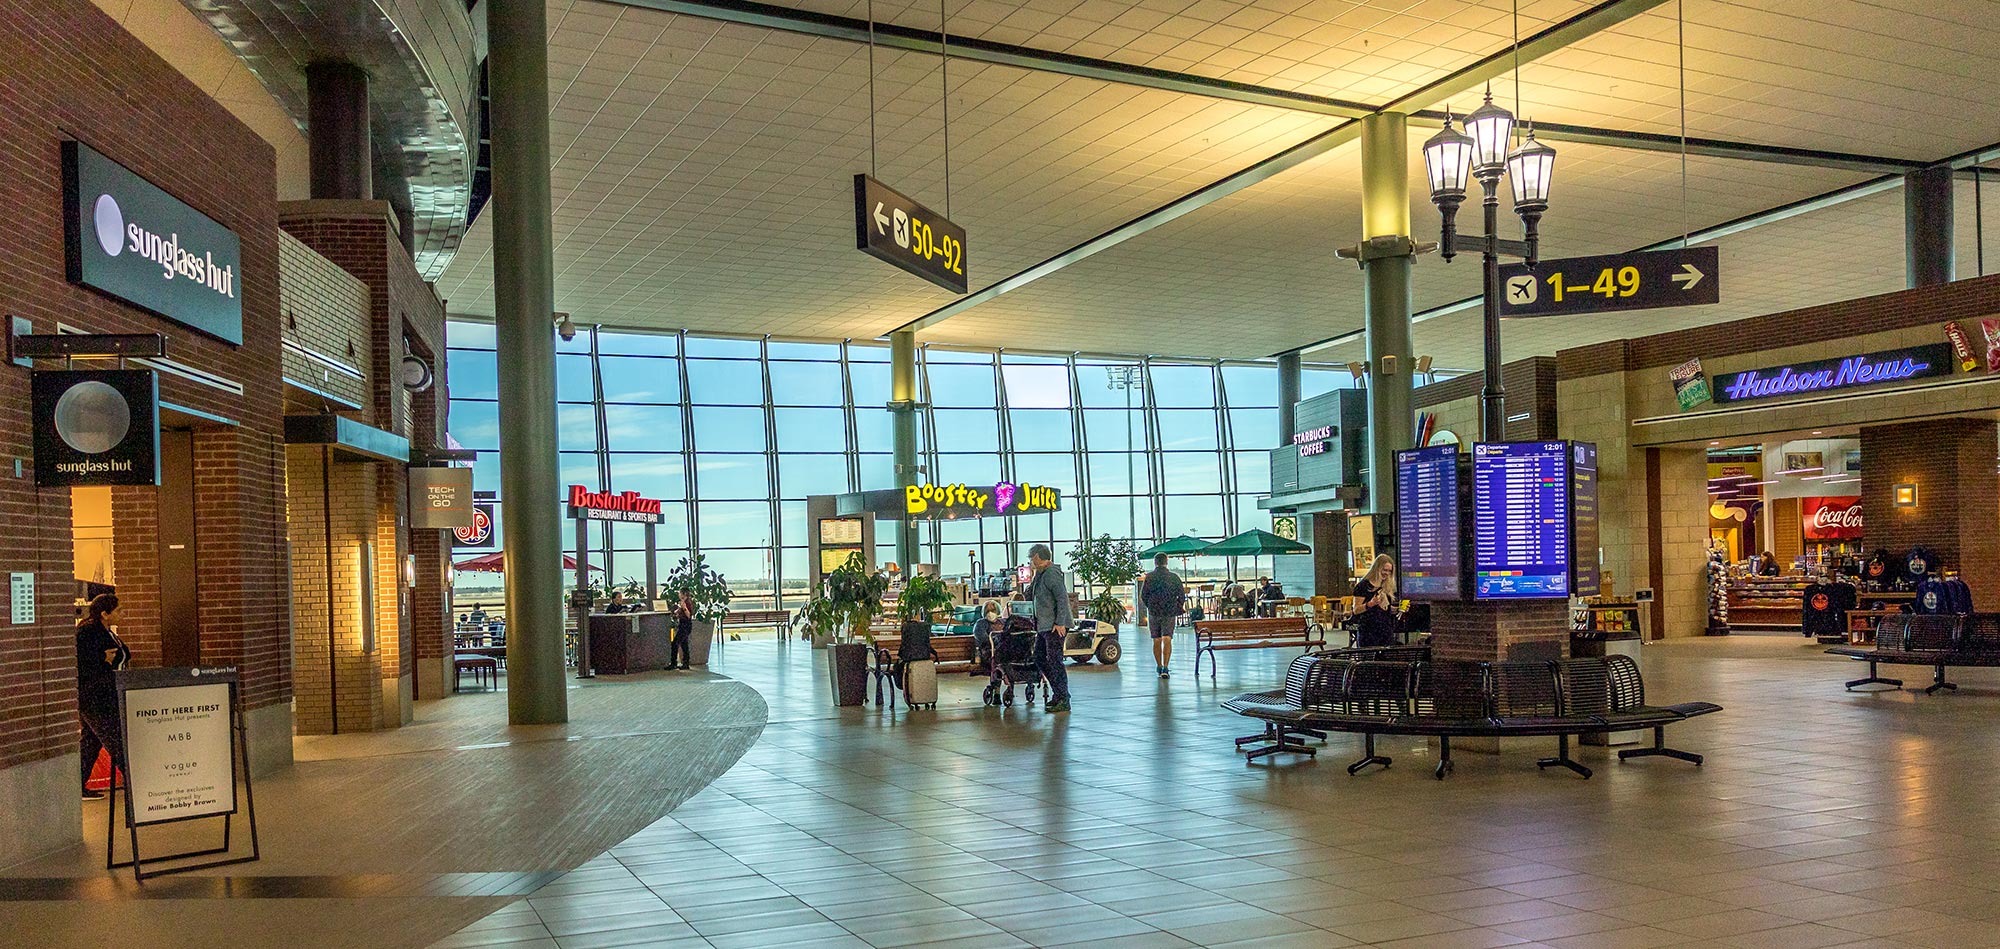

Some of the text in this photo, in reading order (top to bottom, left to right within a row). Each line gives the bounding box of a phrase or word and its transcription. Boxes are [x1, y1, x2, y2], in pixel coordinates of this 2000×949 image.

[127, 223, 234, 298] sunglass hut
[1949, 331, 1968, 358] HALLS
[1725, 356, 1929, 400] Hudson News
[1293, 425, 1330, 445] STARBUCKS
[1300, 441, 1324, 457] COFFEE
[56, 459, 132, 475] sunglass hut
[428, 486, 455, 494] TECH
[432, 499, 451, 508] GO
[905, 482, 1057, 514] Booster Juice
[587, 508, 658, 523] RESTAURANT & SPORTS BAR
[1813, 504, 1863, 528] Coca-Co
[136, 704, 220, 718] FIND IT HERE FIRST
[147, 716, 173, 724] Sunglass
[186, 713, 211, 721] presents
[168, 732, 192, 742] MBB
[163, 762, 197, 771] vogue
[186, 785, 215, 794] exclusives
[164, 793, 202, 803] designed by
[147, 799, 217, 812] Millie Bobby Brown
